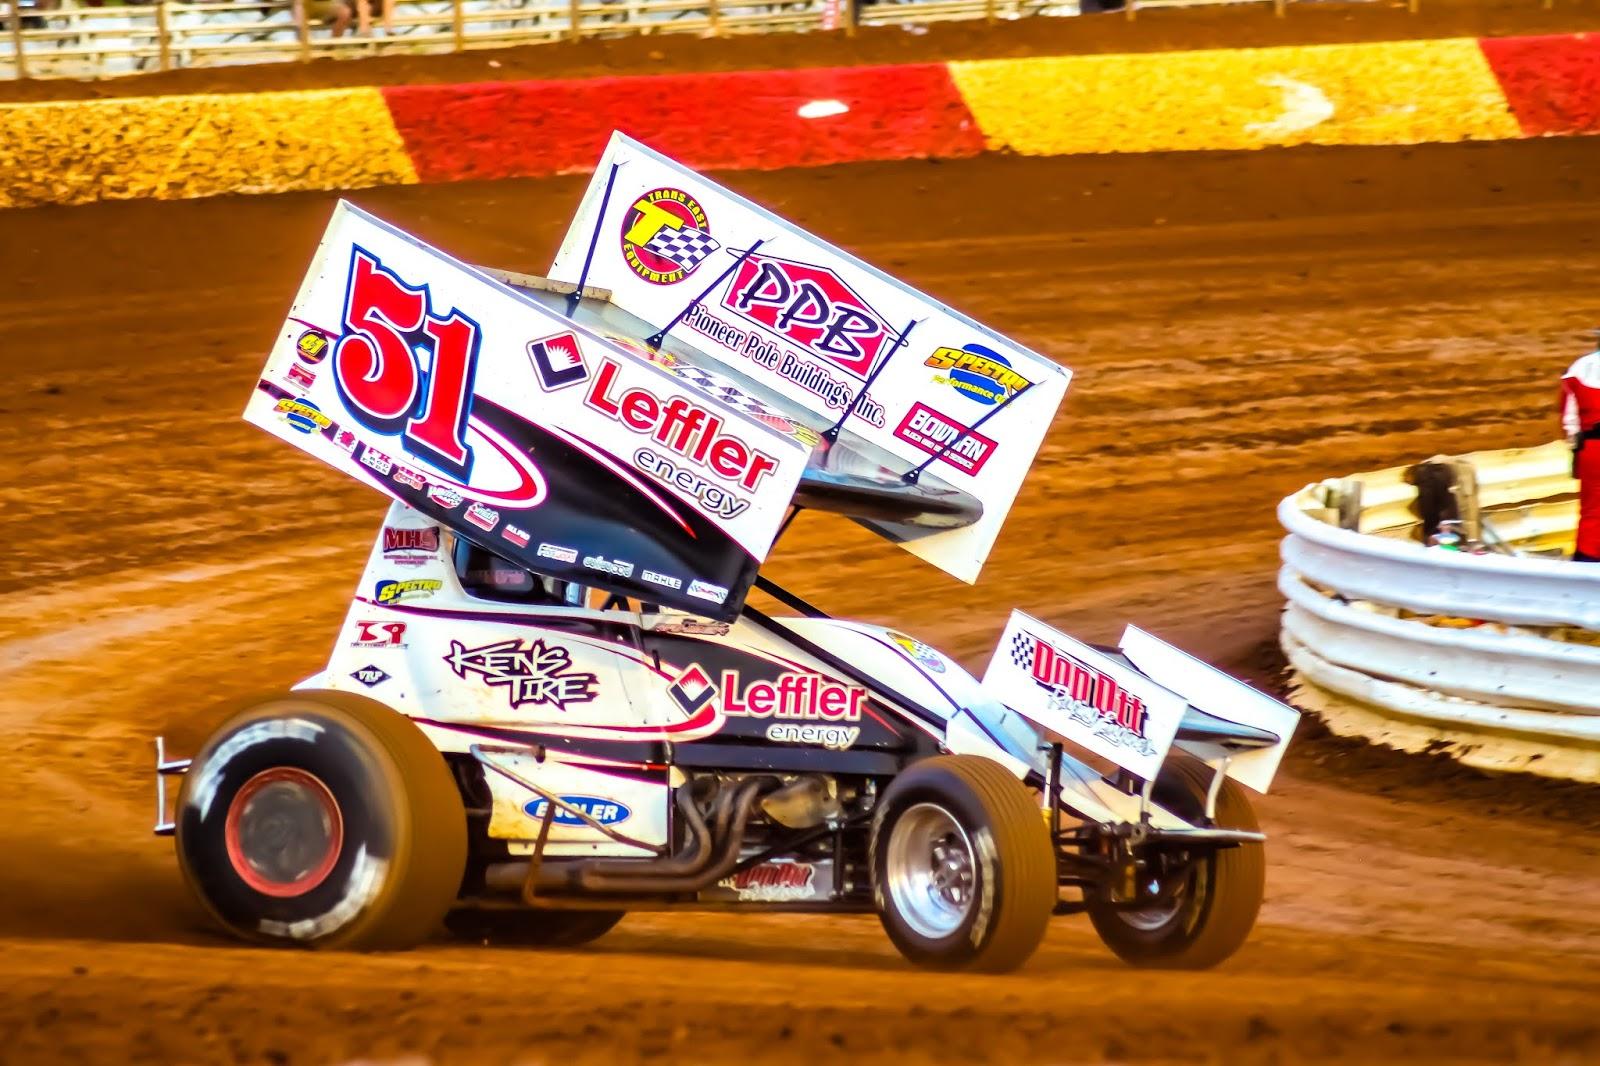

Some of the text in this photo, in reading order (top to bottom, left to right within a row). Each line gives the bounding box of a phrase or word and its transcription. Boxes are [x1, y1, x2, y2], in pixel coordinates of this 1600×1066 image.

[648, 190, 708, 228] TRANS EAST
[623, 243, 683, 283] EQUIPMENT
[737, 260, 880, 361] PPB
[332, 242, 482, 485] 51
[681, 301, 748, 351] Pioneer
[741, 332, 781, 370] Pole
[853, 393, 885, 428] Inc.
[584, 356, 780, 494] Leffler
[908, 408, 988, 462] BOWMAN
[633, 447, 750, 519] energy
[383, 526, 440, 553] MHS
[642, 570, 682, 589] MAHLE
[483, 673, 600, 711] TIRE
[720, 669, 869, 722] Leffler
[767, 723, 861, 750] energy
